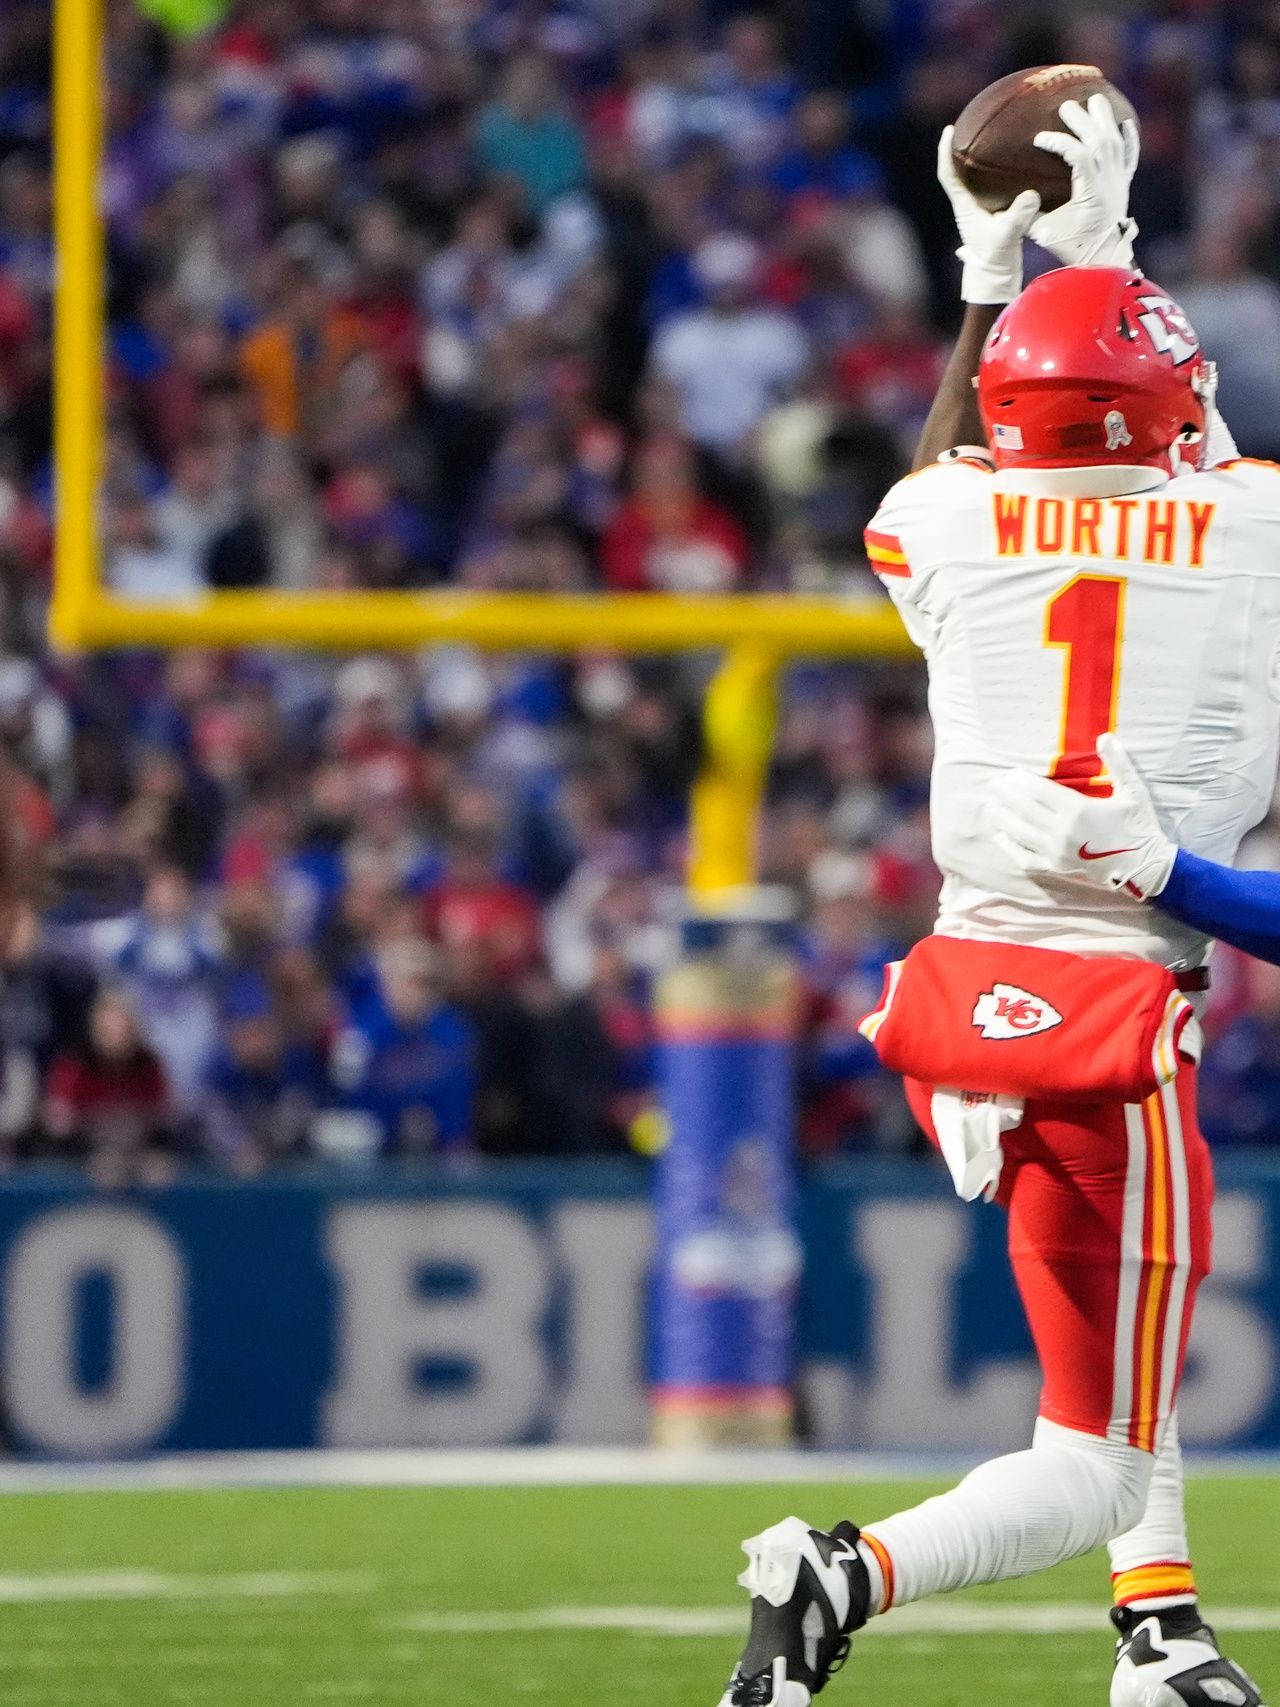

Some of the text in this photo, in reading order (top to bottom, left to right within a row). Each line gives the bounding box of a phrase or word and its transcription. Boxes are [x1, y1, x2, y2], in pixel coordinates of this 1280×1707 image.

[991, 492, 1217, 569] WORTHY
[1043, 572, 1128, 799] 1
[994, 997, 1042, 1030] KC
[318, 1199, 1280, 1450] BIL
